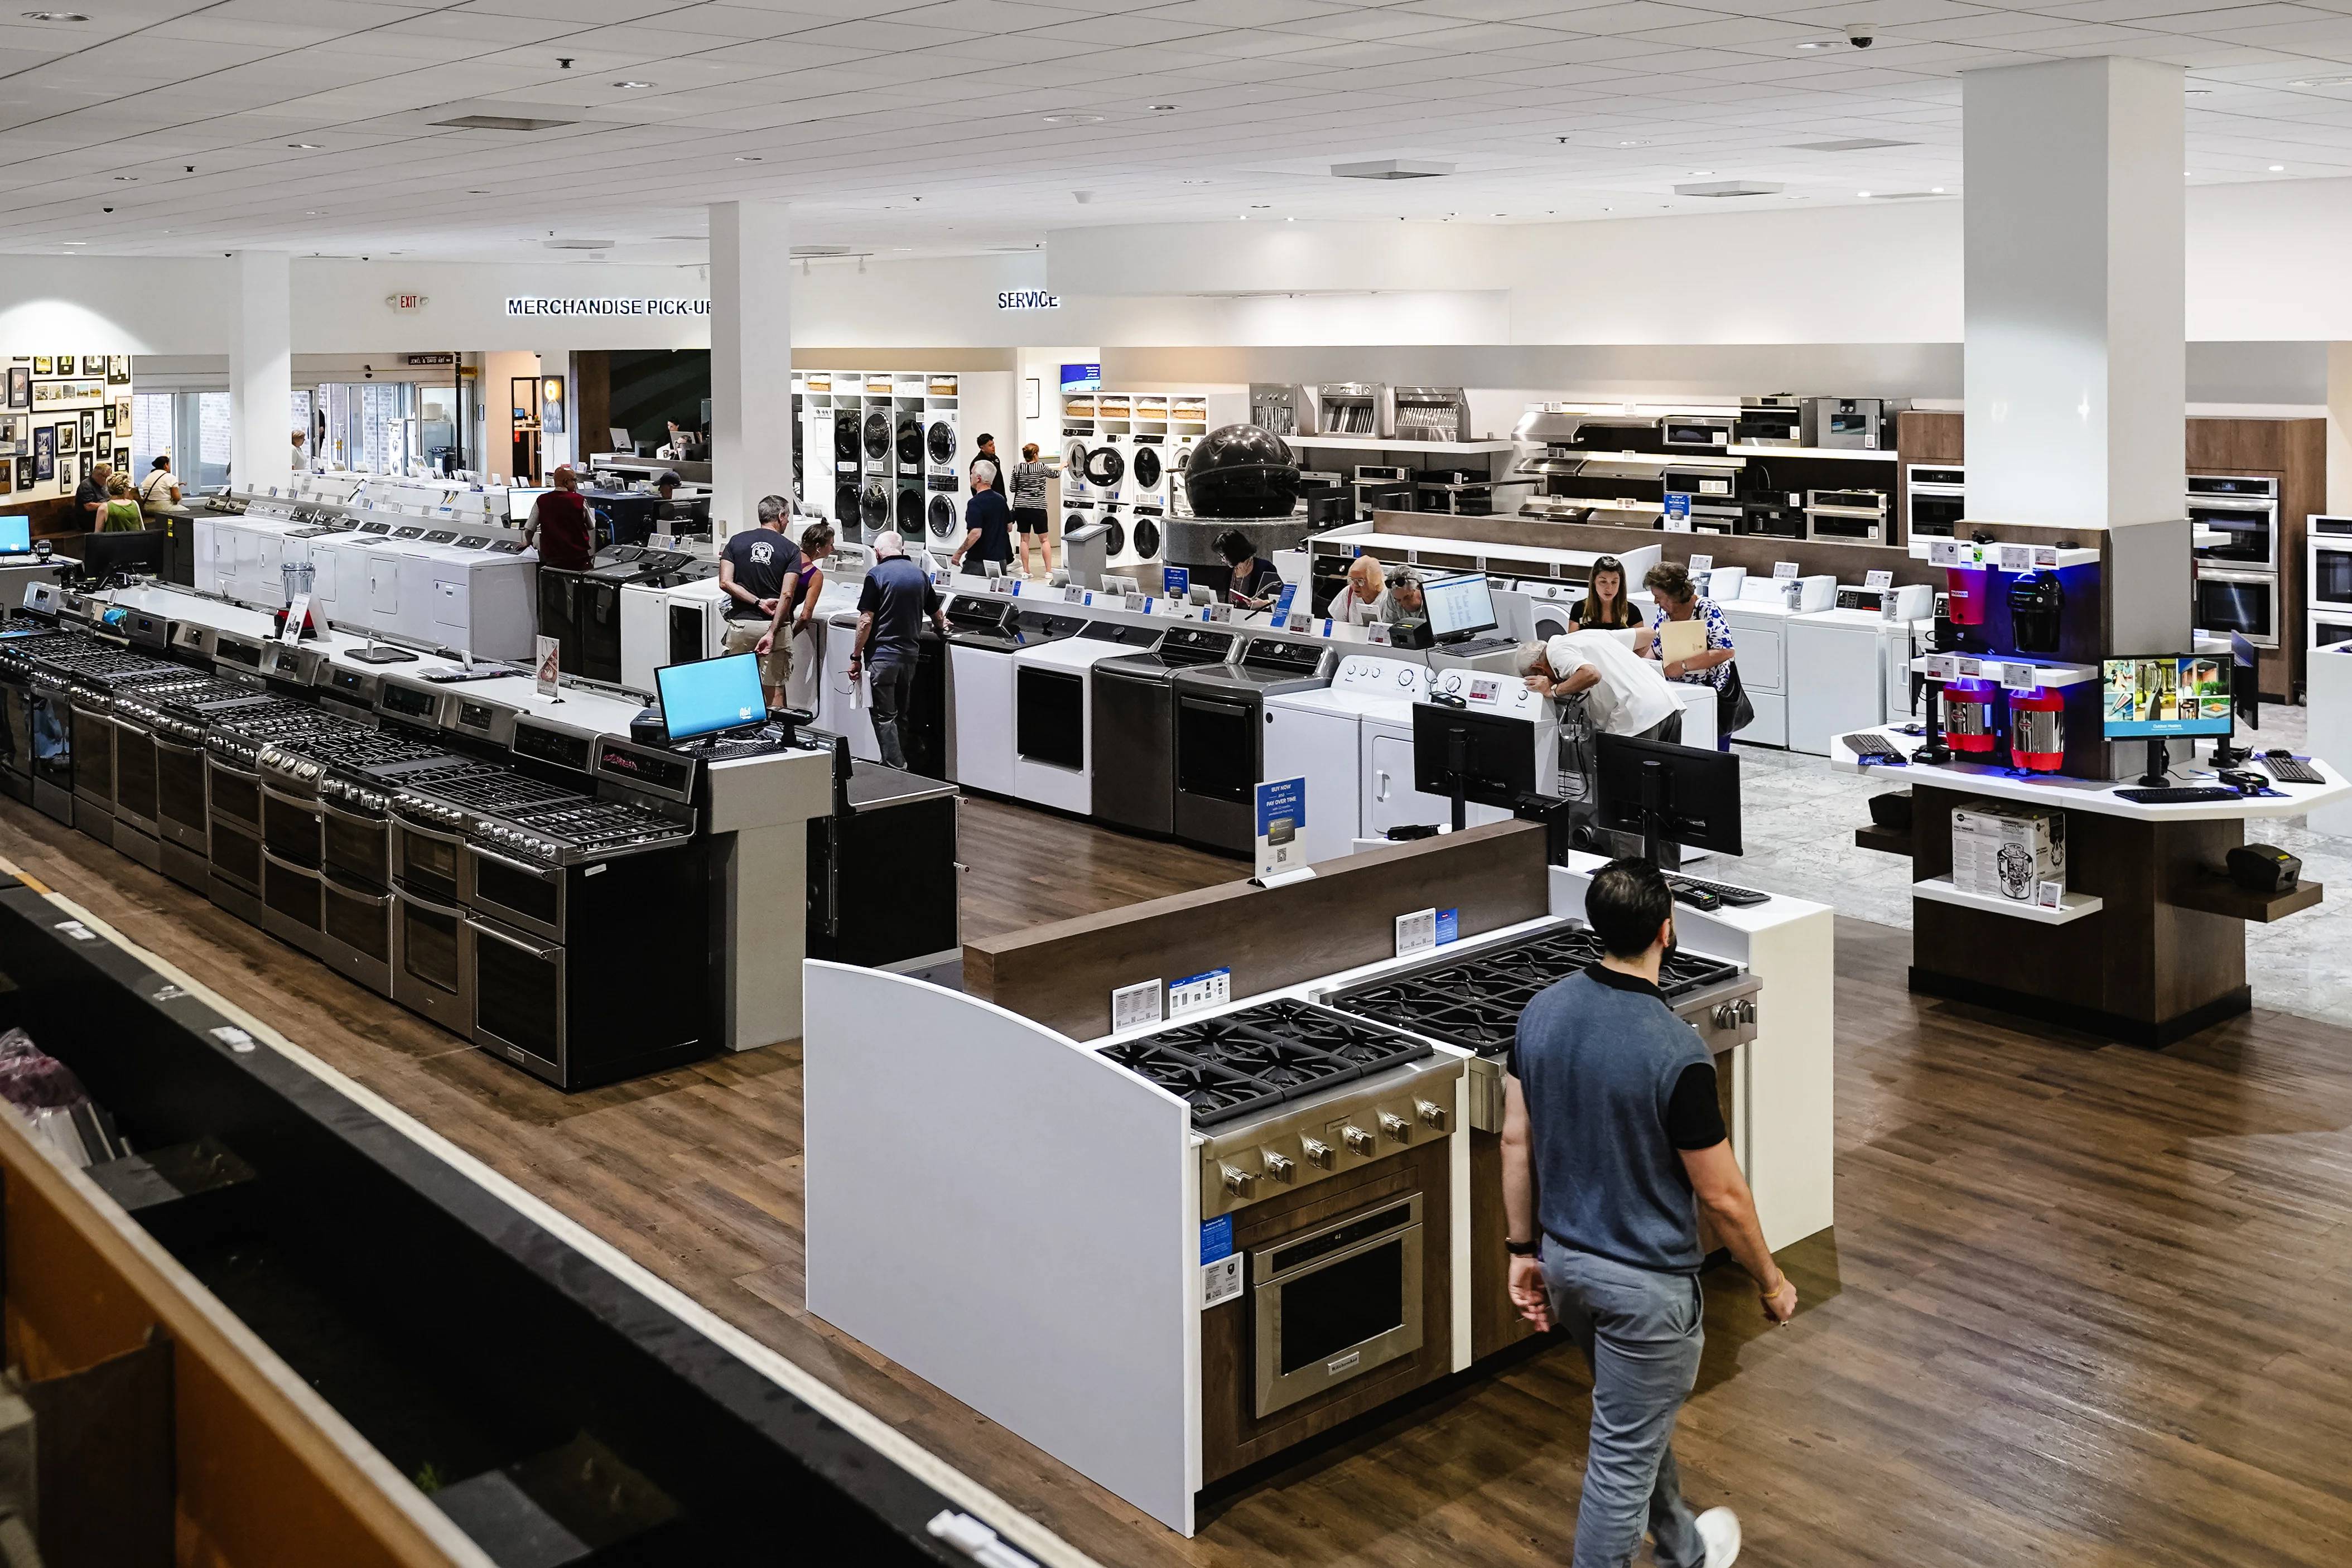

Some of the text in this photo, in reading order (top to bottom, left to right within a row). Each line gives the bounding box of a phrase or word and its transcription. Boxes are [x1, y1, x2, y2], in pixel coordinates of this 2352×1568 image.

[401, 296, 417, 308] EXIT
[998, 291, 1058, 308] SERVICE
[508, 300, 642, 315] MERCHANDISE
[739, 706, 751, 717] Abt
[1332, 1357, 1357, 1371] KitchenAid
